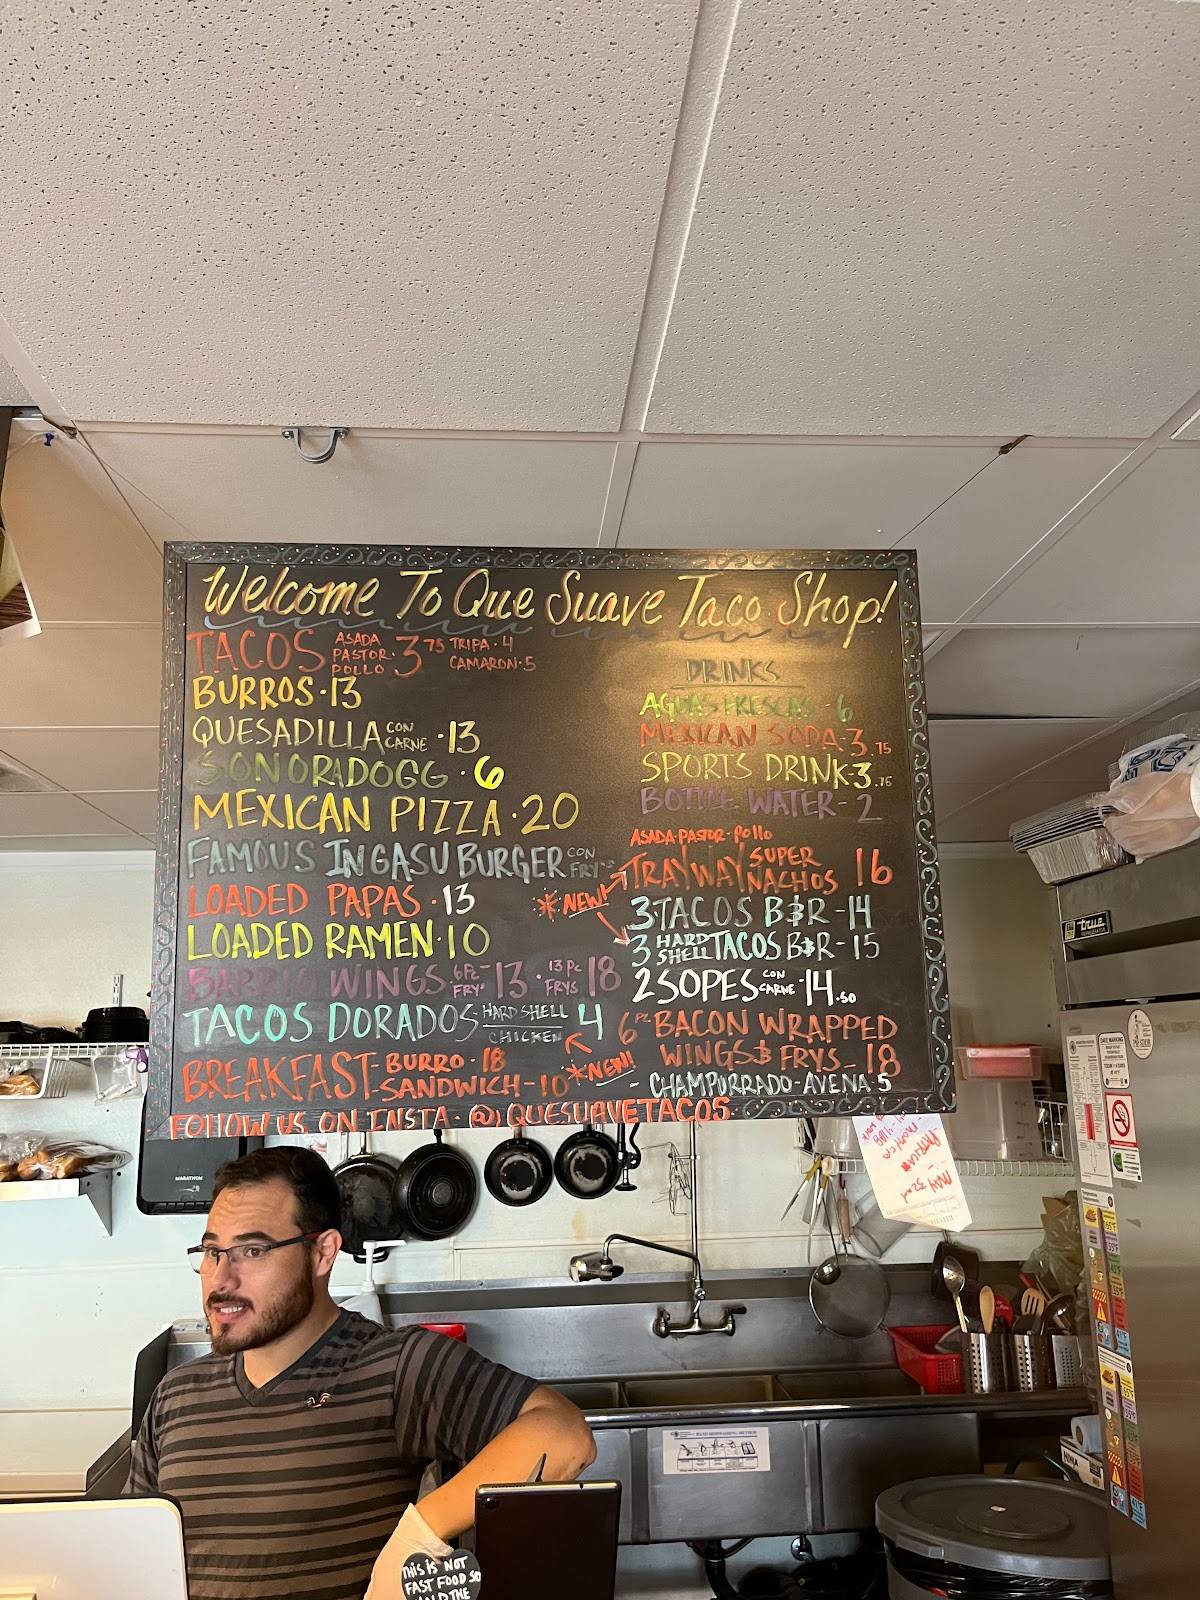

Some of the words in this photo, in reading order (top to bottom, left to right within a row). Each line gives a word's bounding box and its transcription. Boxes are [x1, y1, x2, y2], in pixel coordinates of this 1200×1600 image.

[201, 564, 380, 617] Welcome
[395, 568, 442, 620] To
[453, 568, 535, 619] Que
[546, 570, 666, 627] Suave
[677, 572, 762, 627] Taco
[777, 570, 898, 648] Shop!
[187, 628, 326, 673] TACOS
[335, 631, 381, 646] ASADA
[449, 636, 490, 652] TRIPA
[331, 664, 384, 677] POLLO
[450, 655, 517, 672] CAMARON
[686, 658, 780, 683] DRINKS
[639, 692, 718, 722] AGUAS
[192, 715, 386, 755] QUESADILLA
[386, 721, 415, 733] CON
[640, 720, 758, 750] MEXICAN
[385, 736, 428, 752] CARNE
[641, 751, 753, 784] SPORTS
[193, 788, 371, 835] MEXICAN
[391, 795, 502, 837] PIZZA
[641, 787, 739, 815] BOTTLE
[186, 836, 316, 879] FAMOUS
[457, 841, 567, 884] BURGER
[567, 846, 595, 859] CON
[749, 847, 822, 868] SUPER
[856, 847, 894, 887] 16
[747, 870, 839, 895] NACHOS
[188, 883, 309, 918] LOADED
[327, 882, 421, 919] PAPAS
[187, 920, 314, 960] LOADED
[325, 918, 433, 961] RAMEN
[656, 947, 714, 966] SHELL
[329, 962, 447, 1000] WINGS
[588, 955, 622, 997] 18
[657, 968, 759, 1005] SOPES
[762, 969, 785, 979] CON
[759, 983, 796, 996] CARNE
[182, 1001, 313, 1047] TACOS
[328, 1001, 479, 1042] DORADOS
[578, 1003, 604, 1041] 4
[483, 1003, 518, 1022] HARD
[520, 1003, 569, 1021] SHELL
[655, 1008, 749, 1038] BACON
[758, 1007, 898, 1044] WRAPPED
[489, 1030, 562, 1044] CHICKEN
[779, 1044, 840, 1072] FRYS
[181, 1050, 377, 1104] BREAKFAST
[277, 1111, 308, 1136] US
[319, 1108, 357, 1134] ON
[367, 1104, 449, 1132] INSTA
[443, 1556, 468, 1571] NOT
[405, 1578, 434, 1595] FAST
[437, 1573, 466, 1589] FOOD
[469, 1570, 481, 1583] SO
